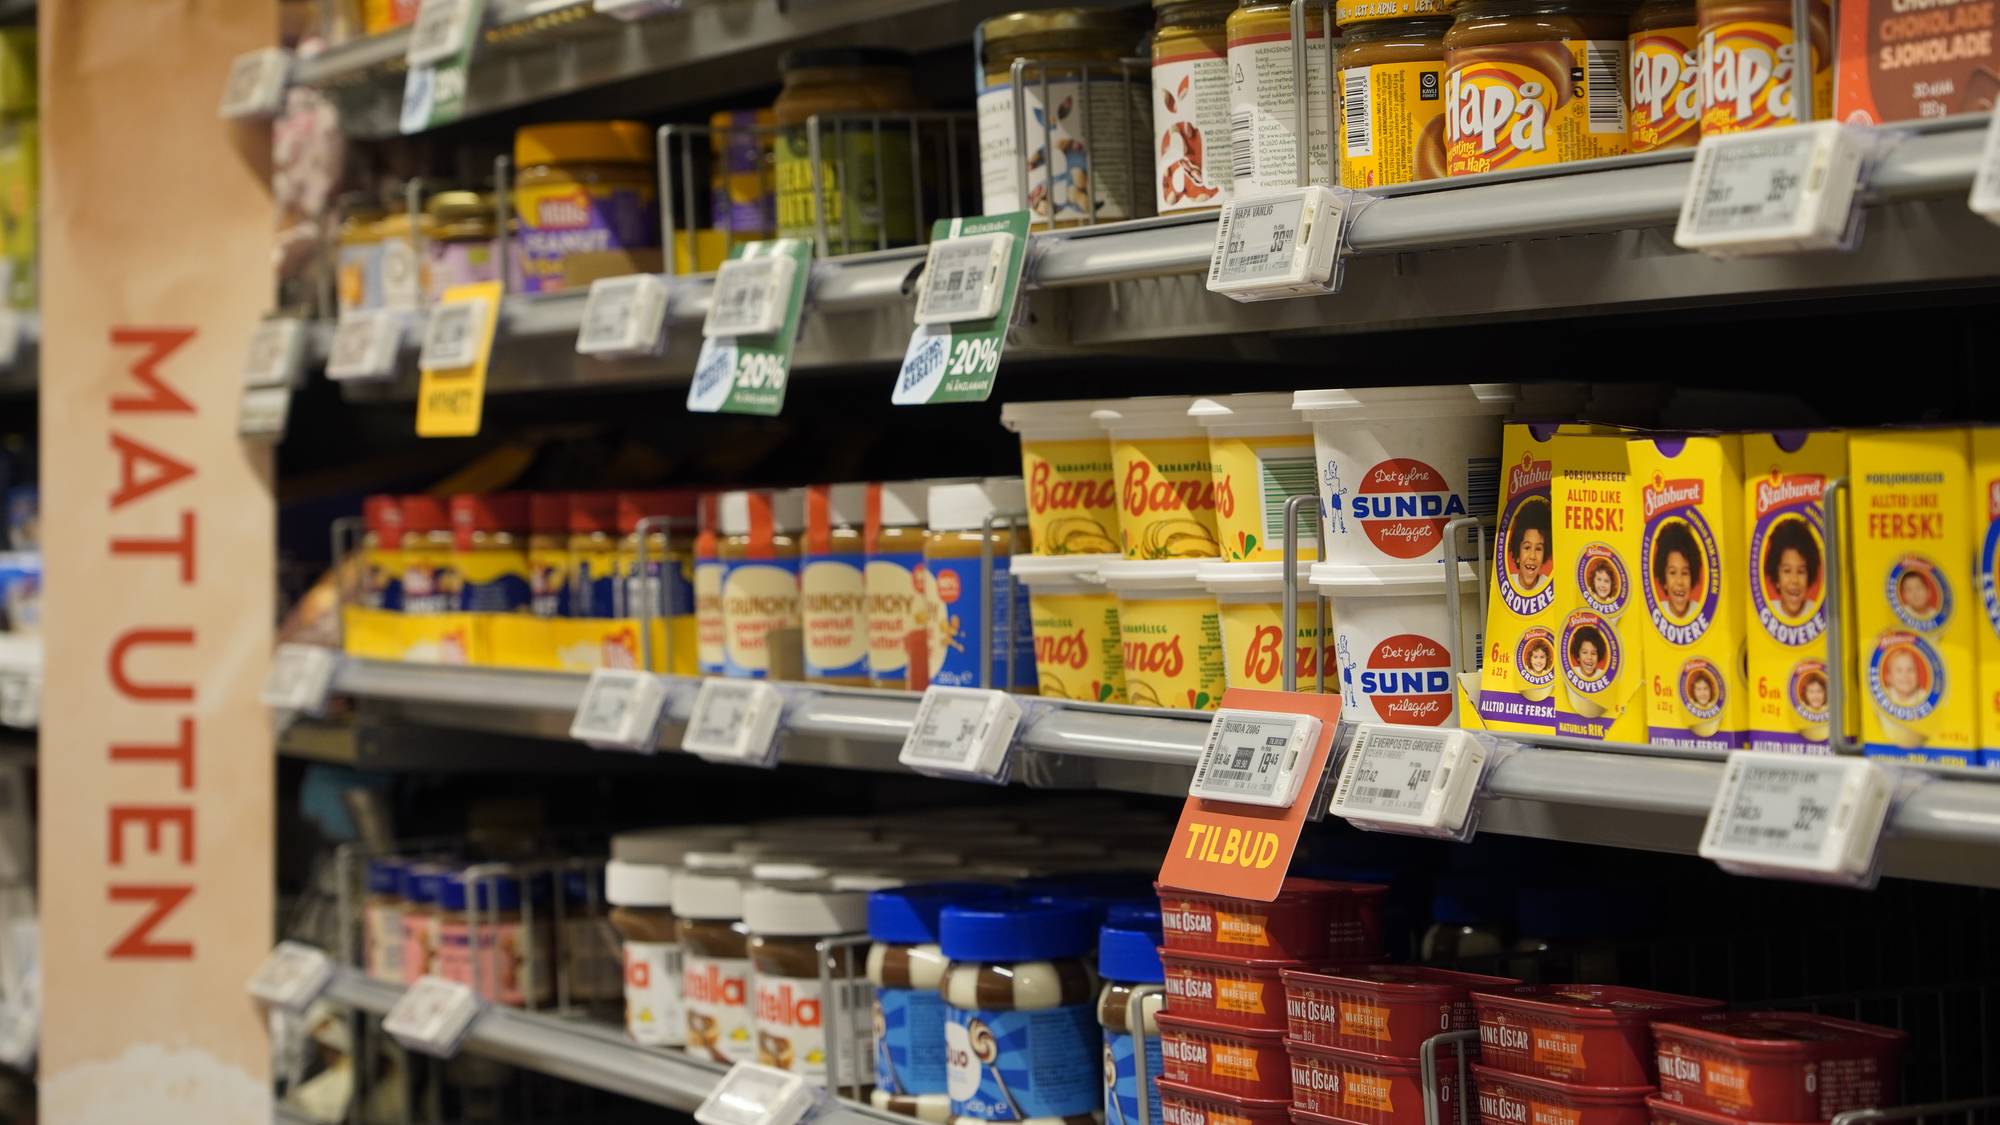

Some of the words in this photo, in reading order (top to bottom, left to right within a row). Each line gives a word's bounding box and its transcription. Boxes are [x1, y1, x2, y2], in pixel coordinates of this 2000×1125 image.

[1879, 31, 1993, 70] SJOKOLADE
[1445, 69, 1545, 153] Hapå
[949, 337, 999, 375] -20%
[735, 352, 785, 389] -20%
[110, 327, 197, 585] MAT
[1375, 469, 1395, 483] Det
[1398, 467, 1430, 486] gylne
[1564, 470, 1626, 483] PORSJONSBEGER
[1352, 494, 1466, 519] SUNDA
[1567, 490, 1597, 503] ALLTID
[1600, 490, 1621, 503] LIKE
[1644, 485, 1700, 516] Stabburet
[1759, 480, 1822, 512] Stabburet
[1872, 494, 1907, 508] ALLTID
[1565, 506, 1624, 532] FERSK!
[1869, 513, 1944, 539] FERSK!
[1380, 524, 1432, 542] pålegget
[1501, 584, 1555, 614] GROVERE
[1652, 609, 1710, 645] GROVERE
[1760, 612, 1827, 645] GROVERE
[1381, 645, 1401, 659] Det
[1404, 643, 1436, 661] gylne
[1491, 643, 1499, 662] 6
[1499, 652, 1510, 664] stk
[1361, 671, 1449, 693] SUND
[1496, 667, 1503, 677] 22
[1567, 670, 1610, 693] GROVERE
[1653, 675, 1662, 696] 6
[1759, 677, 1768, 699] 6
[1388, 699, 1439, 717] pålegget
[1481, 700, 1504, 713] ALLTID
[1506, 702, 1524, 715] LIKE
[1525, 704, 1556, 719] FERSK!
[1227, 723, 1245, 733] SUNDA
[1588, 723, 1604, 737] RIK
[1369, 736, 1412, 750] LEVERPOSTEI
[108, 627, 196, 961] UTEN
[1185, 823, 1279, 869] TILBUD
[1183, 911, 1212, 932] OSCAR
[1185, 977, 1212, 999] OSCAR
[1288, 998, 1307, 1019] KING
[1307, 1000, 1336, 1024] OSCAR
[1480, 1024, 1499, 1045] KING
[1500, 1025, 1529, 1050] OSCAR
[1180, 1042, 1208, 1065] OSCAR
[1292, 1068, 1310, 1088] KING
[1311, 1069, 1339, 1093] OSCAR
[1480, 1095, 1498, 1116] KING
[1500, 1097, 1527, 1123] OSCAR
